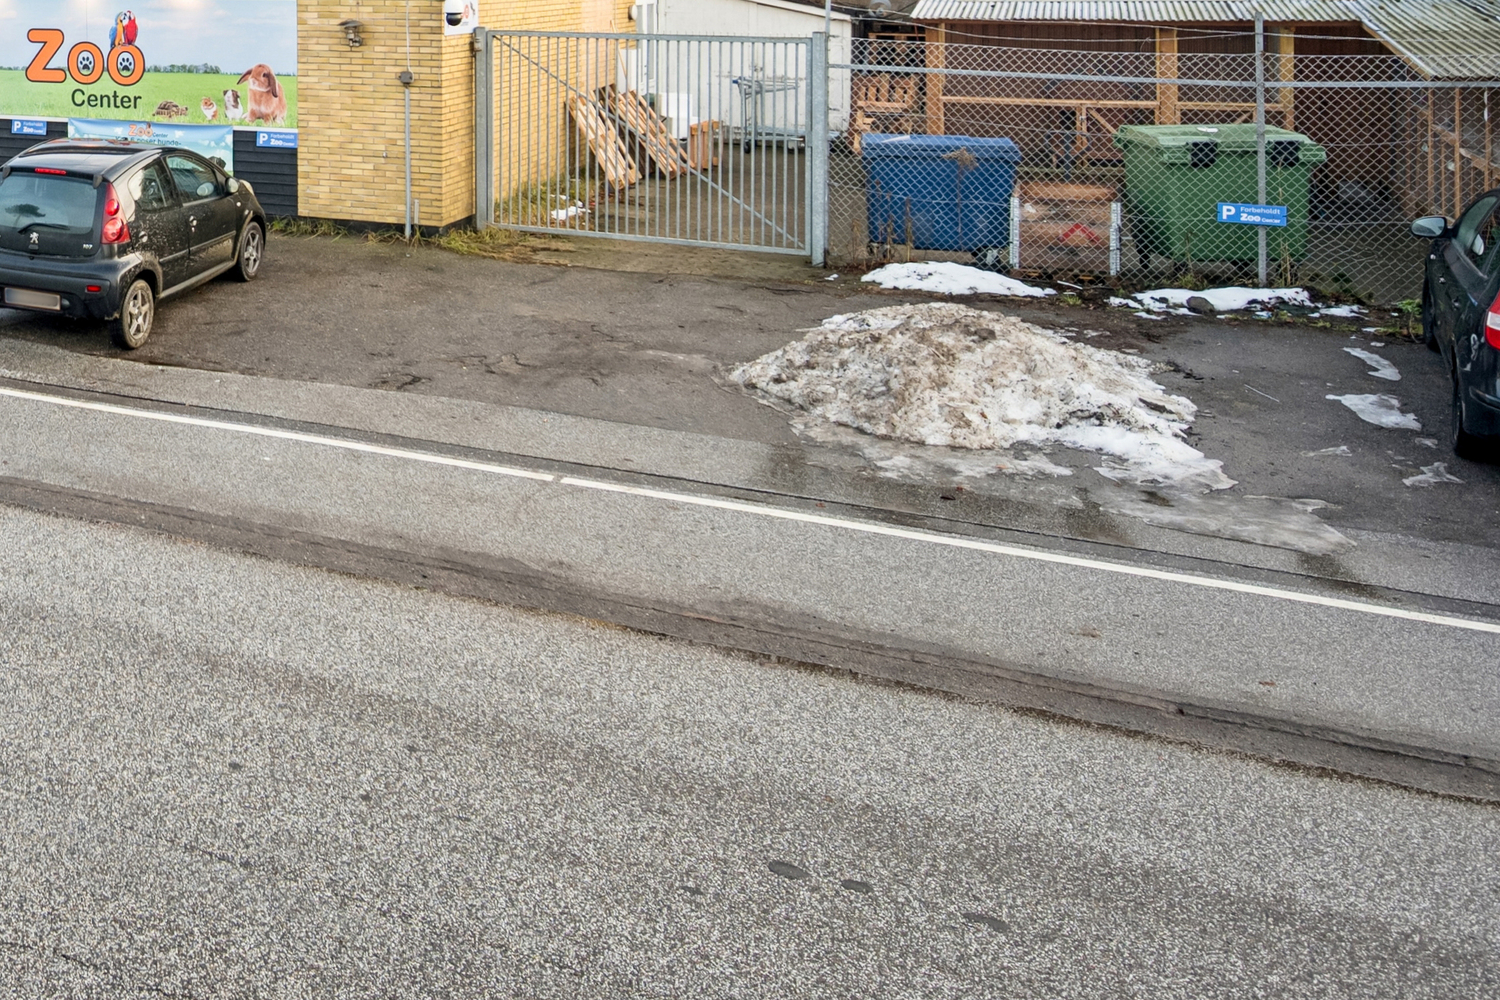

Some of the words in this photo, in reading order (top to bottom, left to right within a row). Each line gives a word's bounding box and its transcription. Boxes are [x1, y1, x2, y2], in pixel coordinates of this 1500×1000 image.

[25, 28, 145, 86] Zoo
[71, 88, 142, 109] Center
[14, 121, 21, 131] P
[128, 124, 153, 137] Zoo
[260, 133, 268, 144] P
[1222, 205, 1236, 220] P
[1240, 206, 1280, 214] Forbeholdt
[1240, 213, 1261, 222] Zoo
